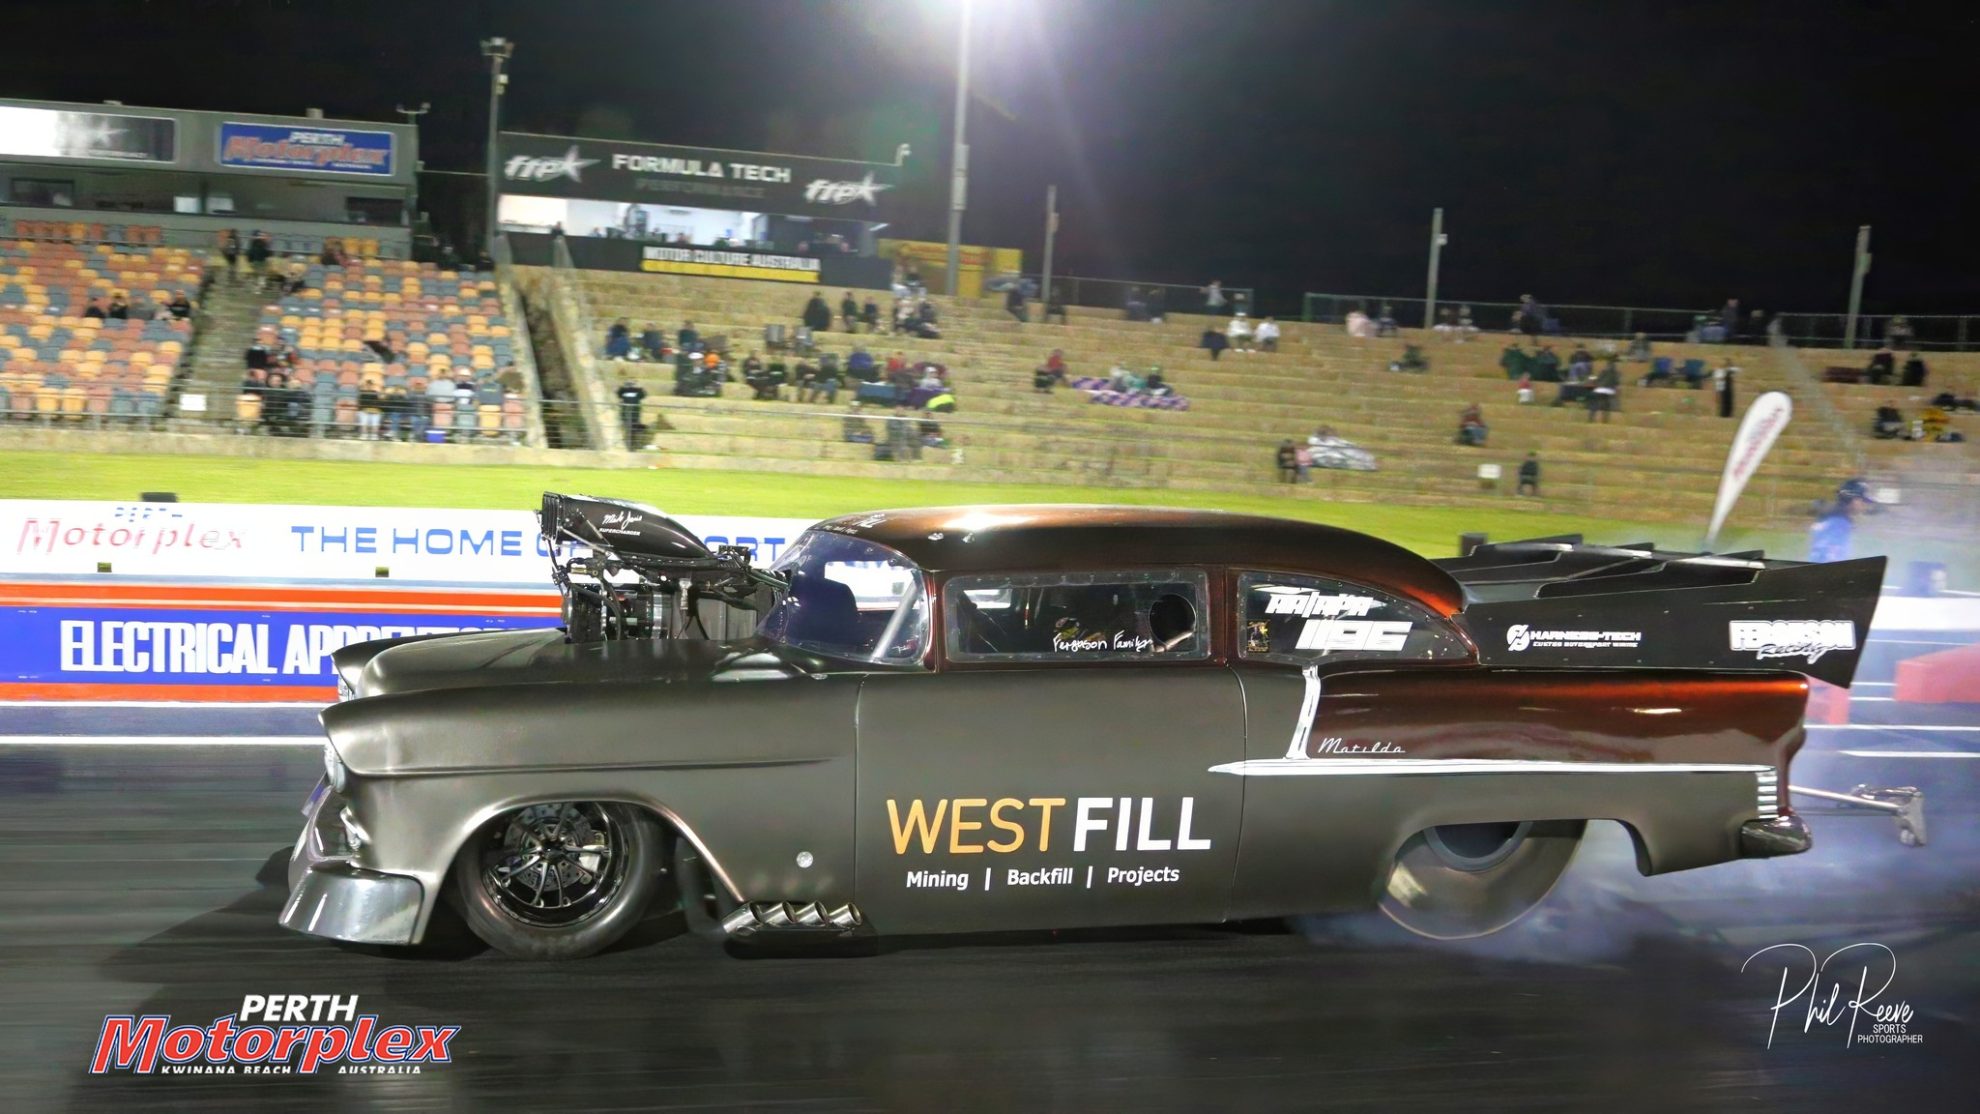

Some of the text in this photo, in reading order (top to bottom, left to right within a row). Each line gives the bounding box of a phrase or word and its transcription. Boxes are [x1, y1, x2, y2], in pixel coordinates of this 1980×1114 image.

[612, 154, 792, 183] FORMULA TECH
[16, 517, 247, 555] Motorplex
[291, 526, 377, 553] THE
[393, 528, 522, 556] HOME
[60, 619, 278, 674] ELECTRICAL
[1053, 632, 1108, 653] Ferguson
[1317, 737, 1406, 754] Matilda
[886, 796, 1211, 855] WEST FILL
[906, 866, 1181, 891] Mining Backfill Projects
